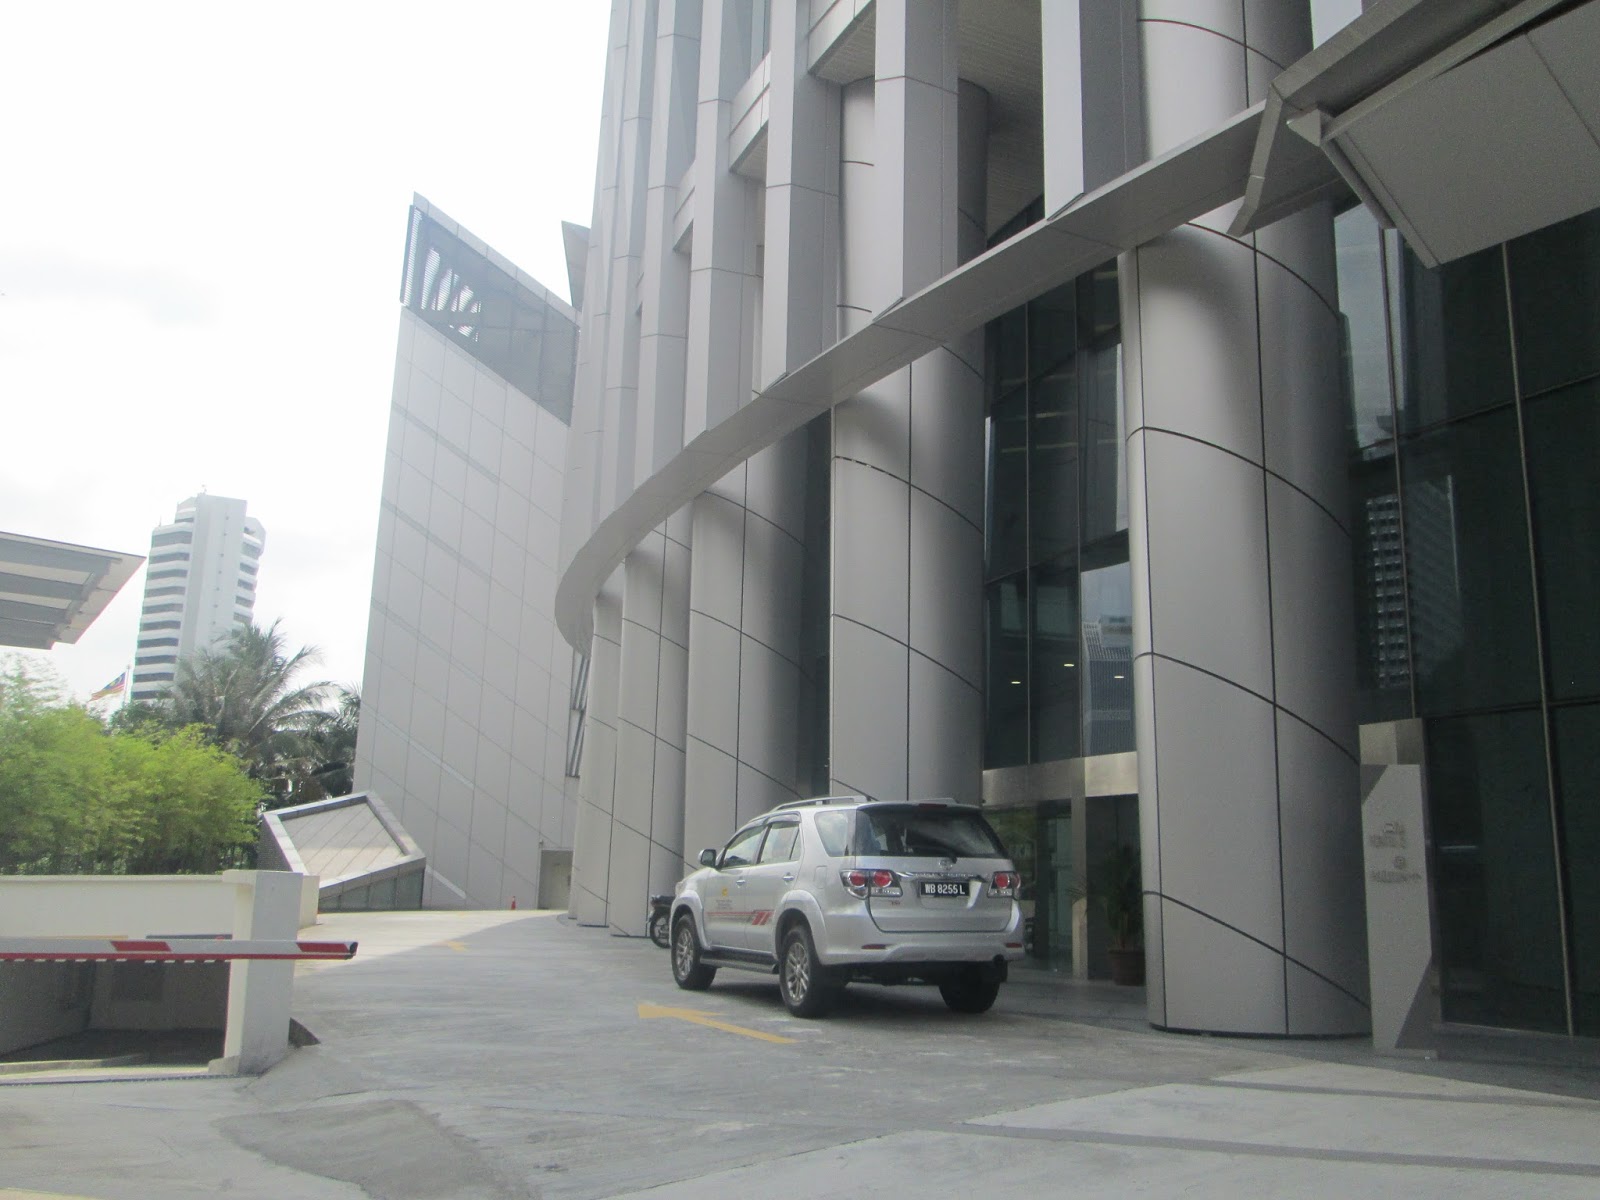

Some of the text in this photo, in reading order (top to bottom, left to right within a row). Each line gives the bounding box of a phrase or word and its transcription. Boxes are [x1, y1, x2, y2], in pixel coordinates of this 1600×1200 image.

[925, 884, 966, 895] WB 8255 L
